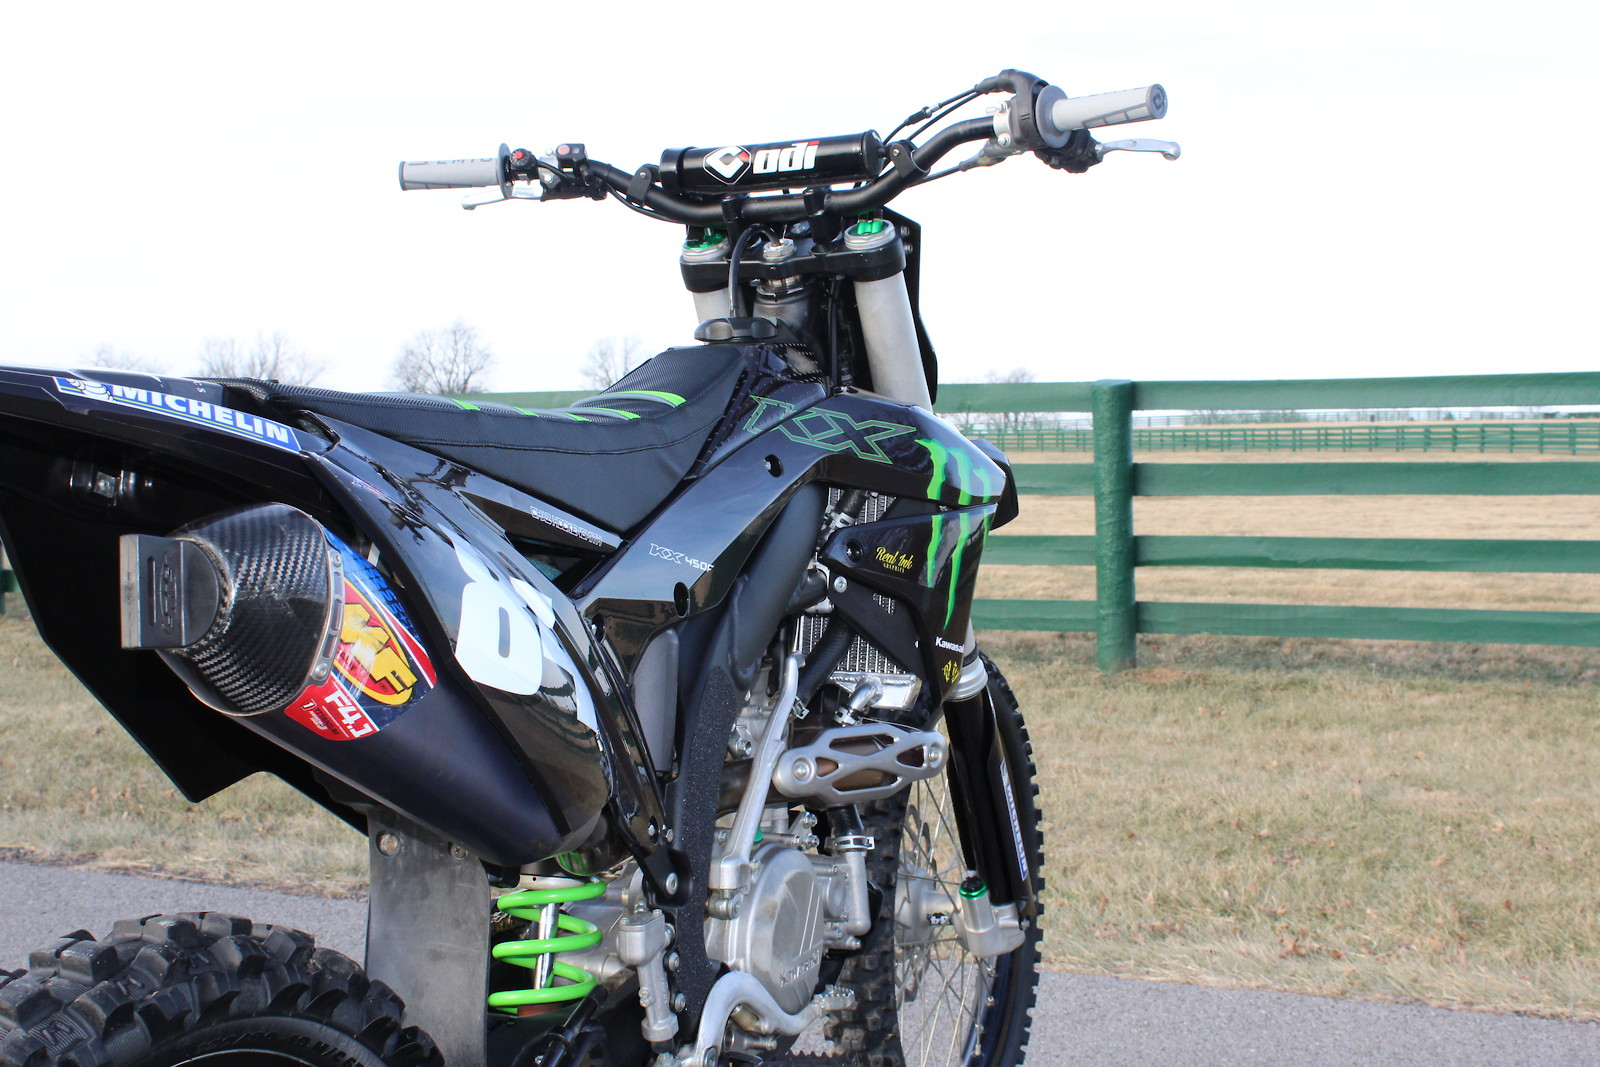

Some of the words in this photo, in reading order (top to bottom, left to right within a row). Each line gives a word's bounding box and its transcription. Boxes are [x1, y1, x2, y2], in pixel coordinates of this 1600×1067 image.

[111, 384, 289, 444] MICHELIN
[743, 394, 916, 465] KX
[649, 542, 685, 564] KX
[685, 556, 715, 572] 450F
[875, 546, 899, 564] Real
[935, 636, 965, 653] Kawasa
[324, 690, 373, 738] F4.1
